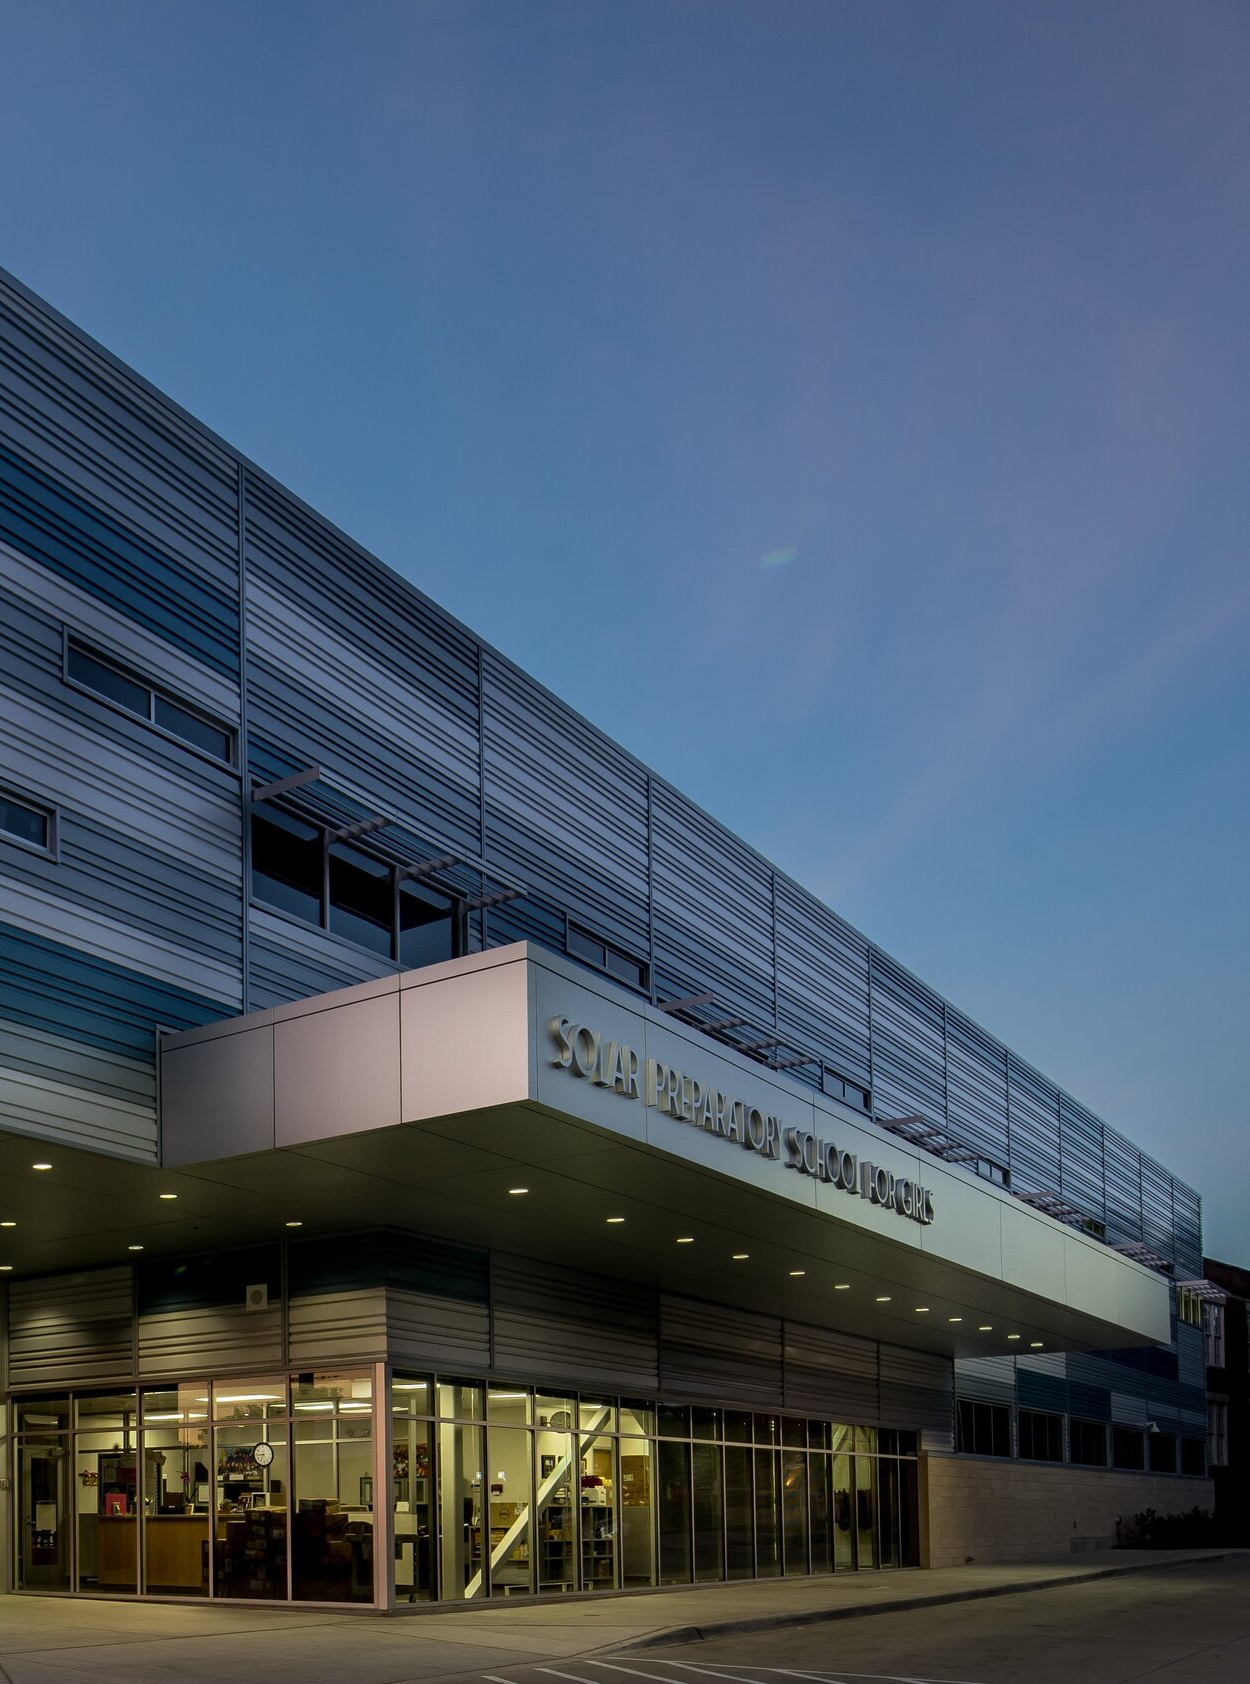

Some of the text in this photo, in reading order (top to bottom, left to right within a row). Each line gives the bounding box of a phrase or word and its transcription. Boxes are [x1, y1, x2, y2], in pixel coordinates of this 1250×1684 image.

[549, 1014, 935, 1226] SOLAR PREPARATORY SCHOOL FOR GIRLS
